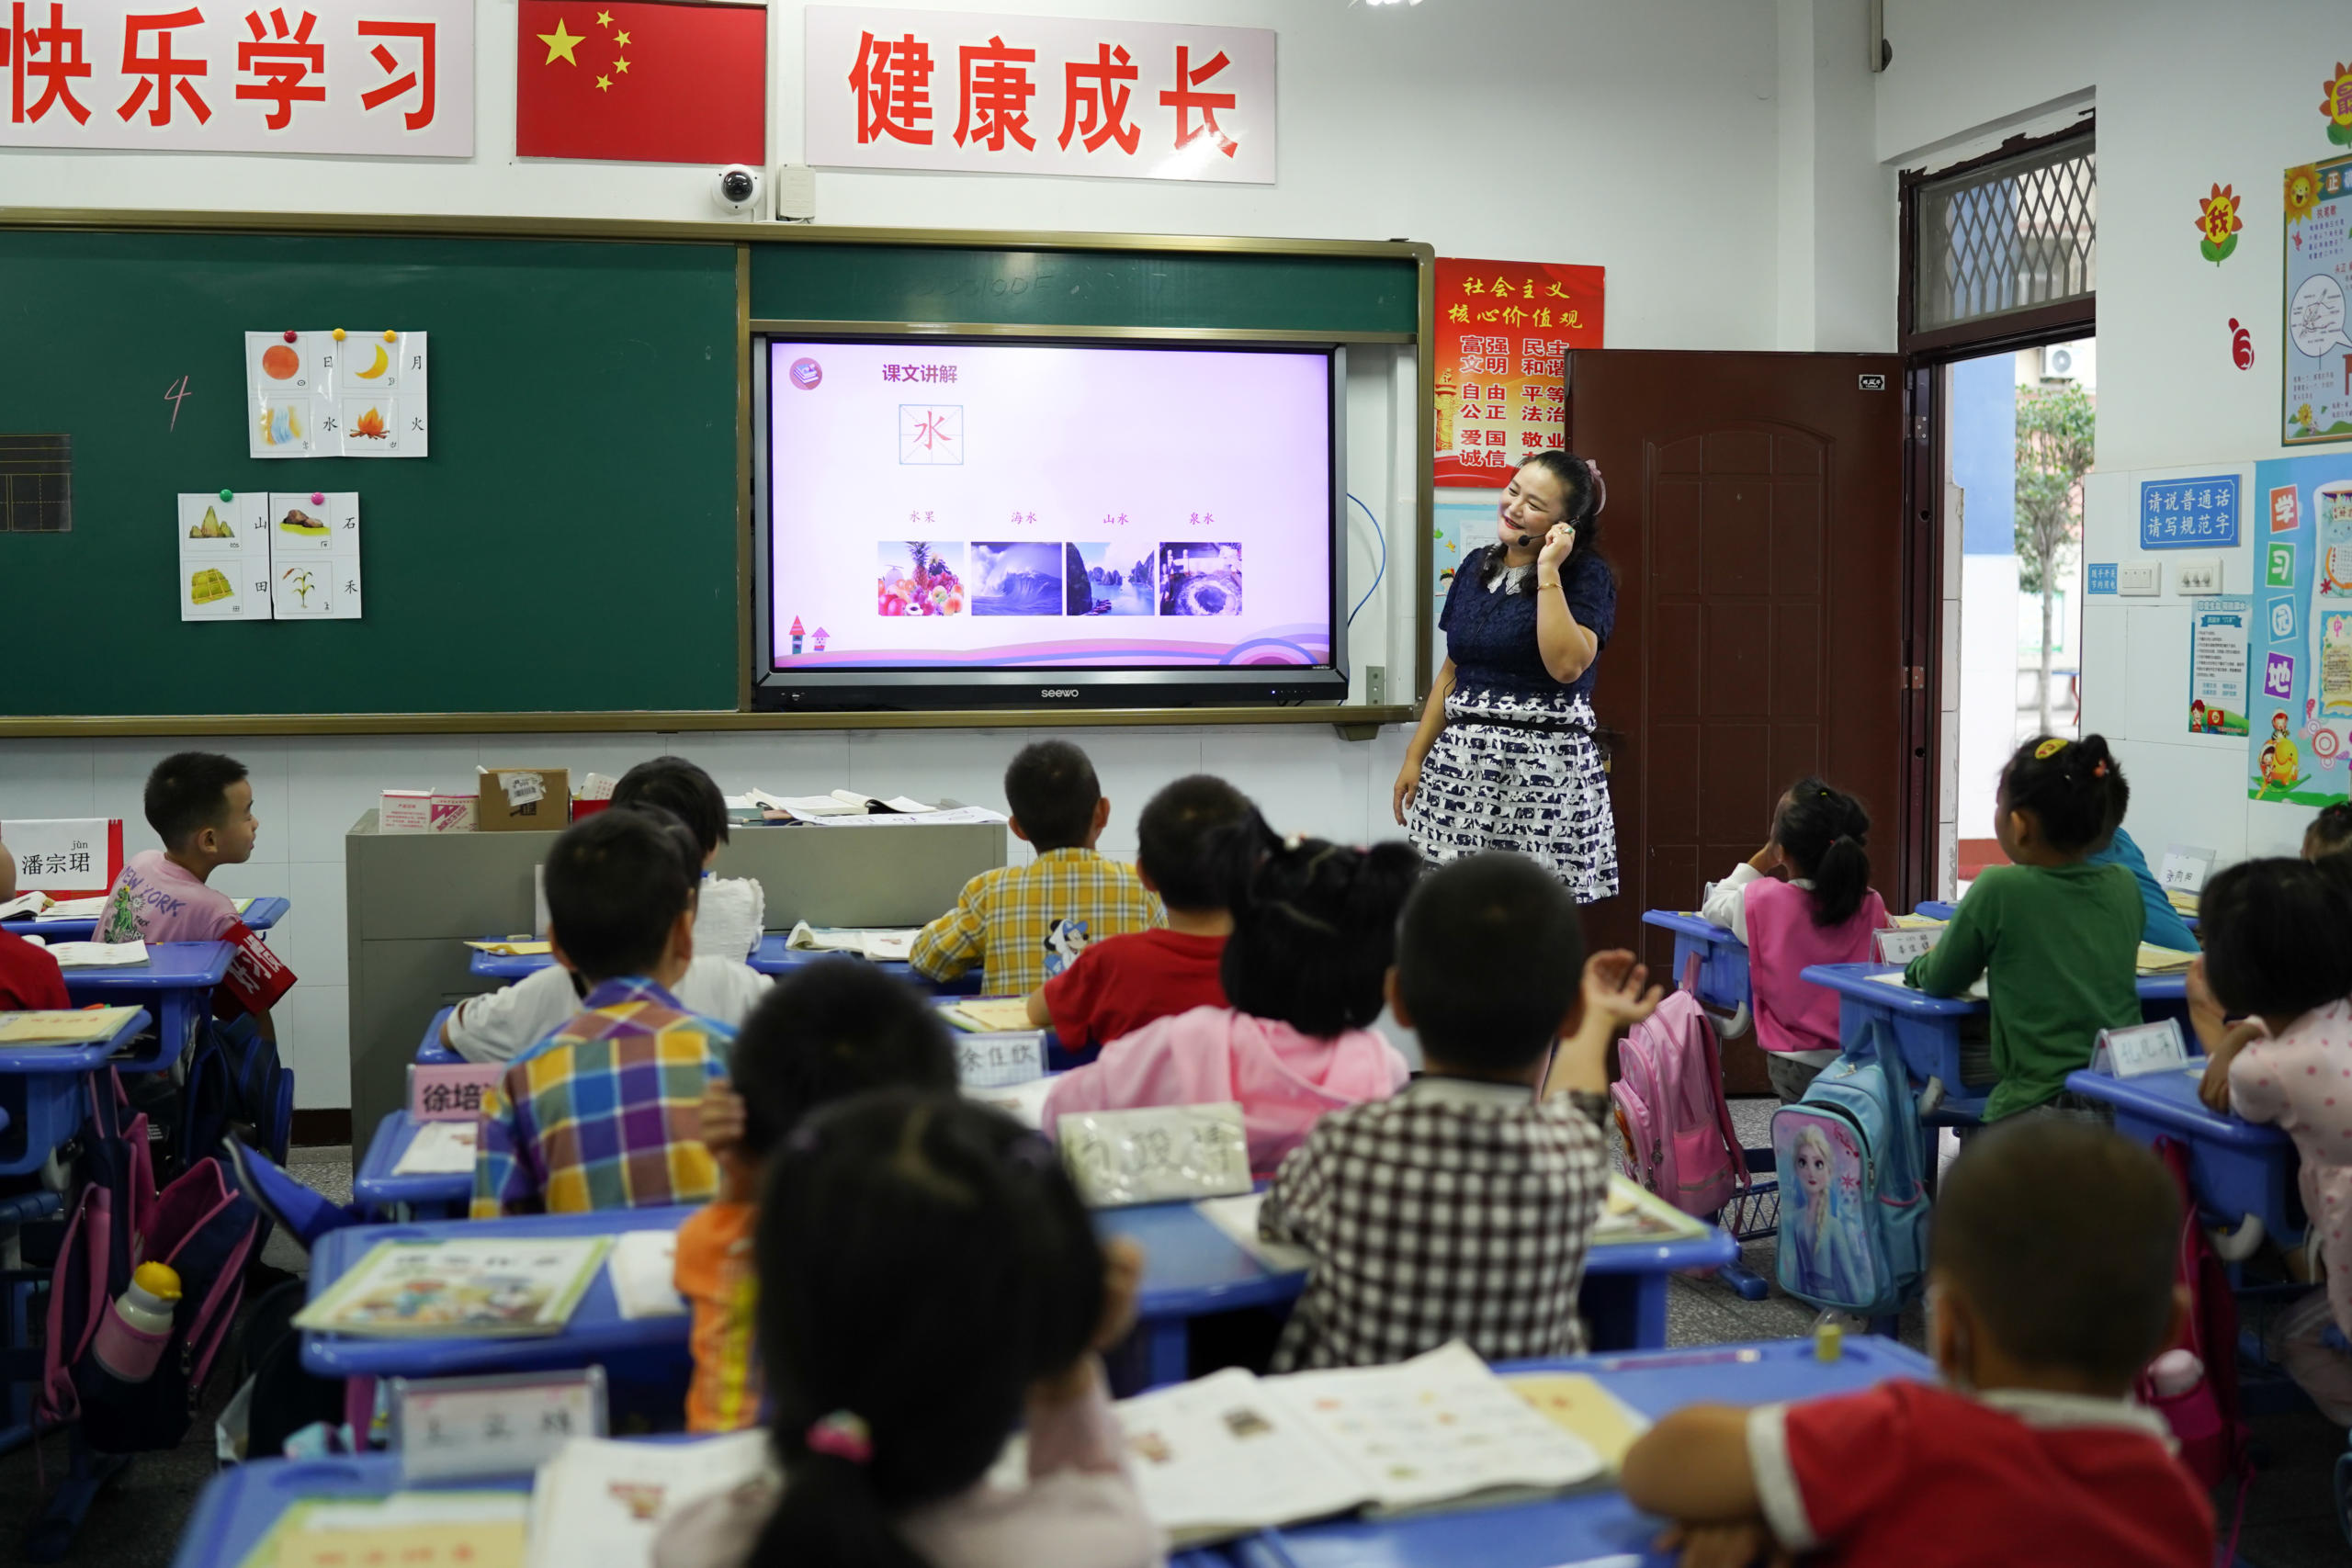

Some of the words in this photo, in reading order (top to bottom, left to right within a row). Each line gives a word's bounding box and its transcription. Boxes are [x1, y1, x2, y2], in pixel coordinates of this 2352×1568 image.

[0, 2, 437, 131] 快乐学习
[848, 29, 1238, 160] 健康成长
[1462, 276, 1570, 299] 社会主义
[1447, 303, 1583, 328] 核心价值观
[1460, 334, 1510, 355] 富强
[1522, 337, 1569, 357] 民主
[322, 355, 334, 368] 日
[411, 355, 423, 370] 月
[1459, 355, 1509, 375] 文明
[1521, 358, 1566, 378] 和谐
[882, 364, 957, 383] 课文讲解
[1461, 383, 1507, 401] 自由
[1521, 385, 1565, 403] 平等
[164, 375, 192, 434] 4
[1459, 403, 1507, 421] 公正
[1521, 405, 1565, 423] 法治
[322, 416, 338, 432] 水
[411, 416, 424, 432] 火
[913, 410, 953, 450] 水
[1459, 429, 1507, 447] 爱国
[1521, 431, 1565, 448] 敬业
[1459, 449, 1507, 468] 诚信
[2147, 488, 2231, 513] 请说普通话
[254, 517, 267, 530] 山
[342, 516, 356, 530] 石
[910, 510, 936, 524] 水果
[1011, 511, 1037, 525] 海水
[1102, 511, 1130, 525] 山水
[1188, 511, 1216, 525] 泉水
[2147, 513, 2231, 537] 请写规范字
[254, 581, 268, 592] 田
[344, 580, 358, 593] 禾
[1041, 689, 1080, 698] seewo
[71, 840, 88, 851] jùn
[22, 852, 90, 874] 潘宗珺
[139, 884, 187, 917] YORK
[423, 1082, 491, 1113] 徐培
